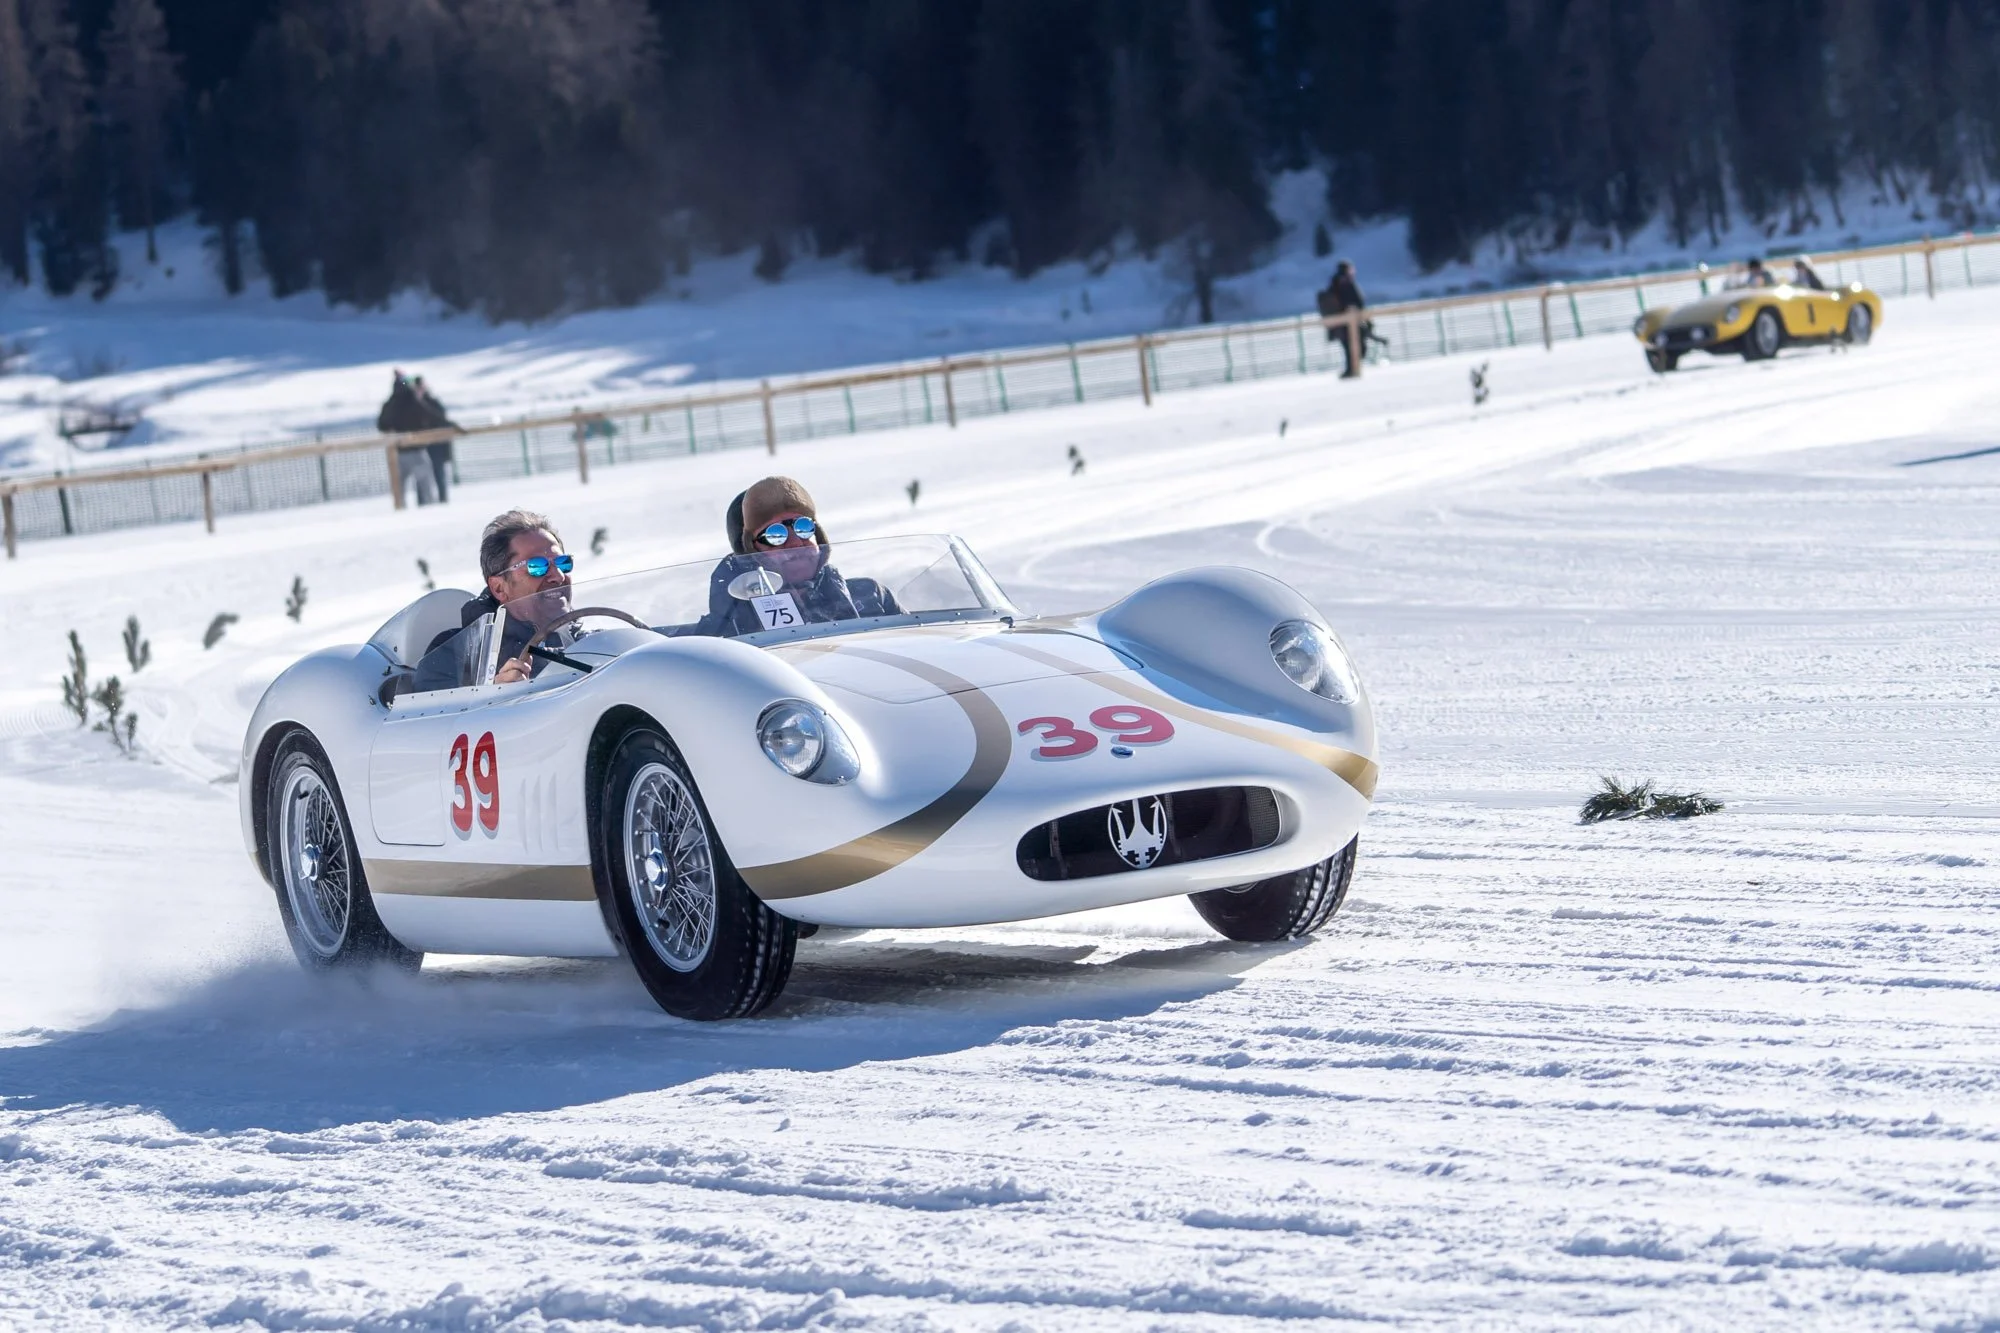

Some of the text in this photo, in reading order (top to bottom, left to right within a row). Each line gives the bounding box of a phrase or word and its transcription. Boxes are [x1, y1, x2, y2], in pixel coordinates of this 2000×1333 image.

[764, 607, 794, 627] 75
[1017, 705, 1175, 761] 39
[448, 731, 500, 840] 39
